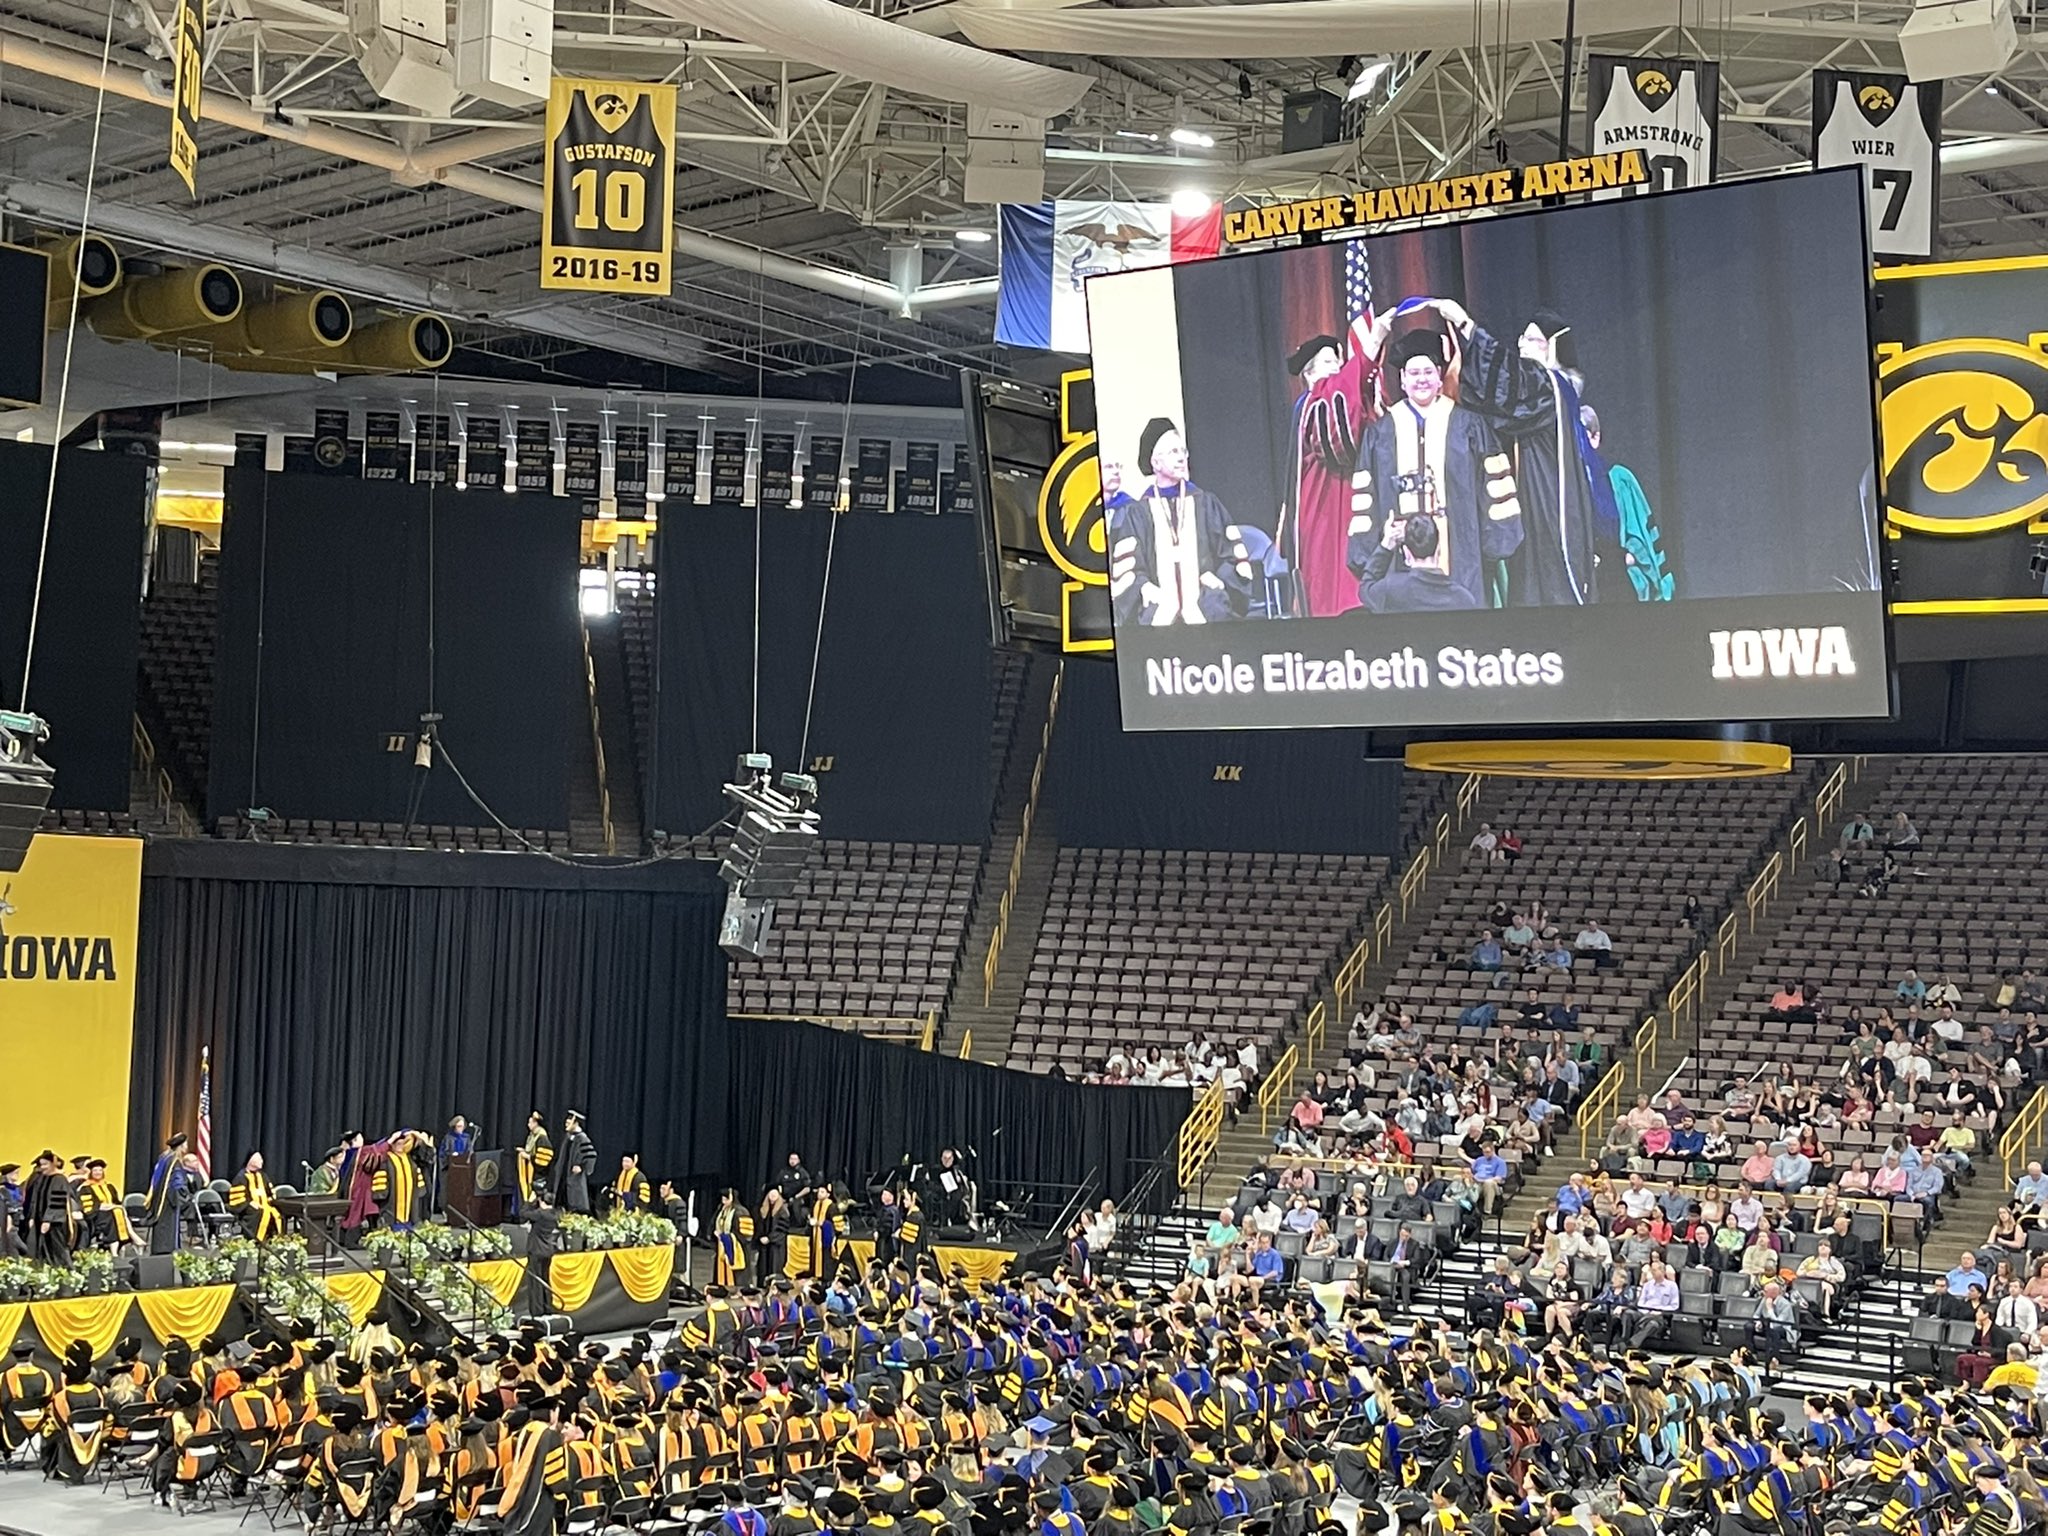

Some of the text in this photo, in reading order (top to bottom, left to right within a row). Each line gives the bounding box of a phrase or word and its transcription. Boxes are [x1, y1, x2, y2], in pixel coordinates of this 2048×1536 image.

[1603, 124, 1704, 151] ARMSTRONG
[1852, 139, 1895, 157] WIER
[564, 143, 656, 168] GUSTAFSON
[571, 168, 646, 232] 10
[1224, 150, 1645, 243] CARVER-HAWKEYE ARENA
[1872, 168, 1913, 231] 7
[552, 256, 660, 283] 2016-19
[666, 482, 695, 494] 1970
[714, 486, 743, 497] 1979
[1708, 625, 1856, 681] IOWA
[1146, 645, 1565, 696] Nicole Elizabeth States
[809, 756, 834, 771] JJ
[1213, 765, 1243, 781] KK
